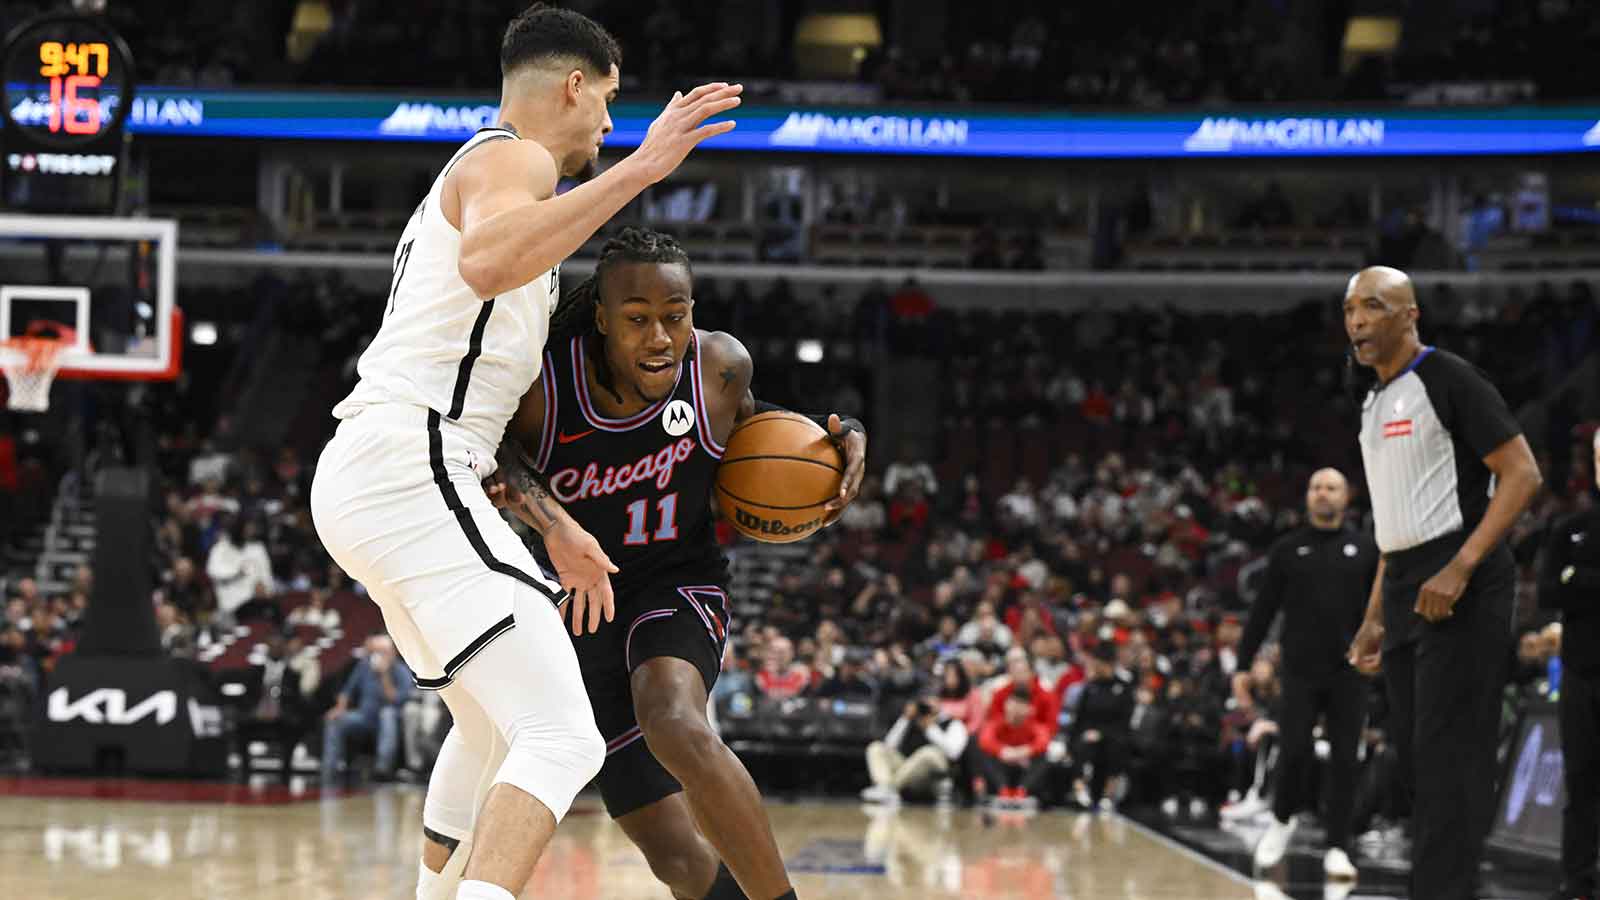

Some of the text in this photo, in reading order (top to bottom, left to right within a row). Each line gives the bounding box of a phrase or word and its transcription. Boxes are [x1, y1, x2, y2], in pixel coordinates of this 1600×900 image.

[40, 41, 109, 78] 9:47
[48, 75, 101, 134] 16
[821, 115, 969, 147] MAGELLAN
[1236, 117, 1384, 149] MAGELLAN
[549, 436, 697, 503] Chicago
[623, 491, 679, 546] 11
[735, 507, 822, 535] Wilson
